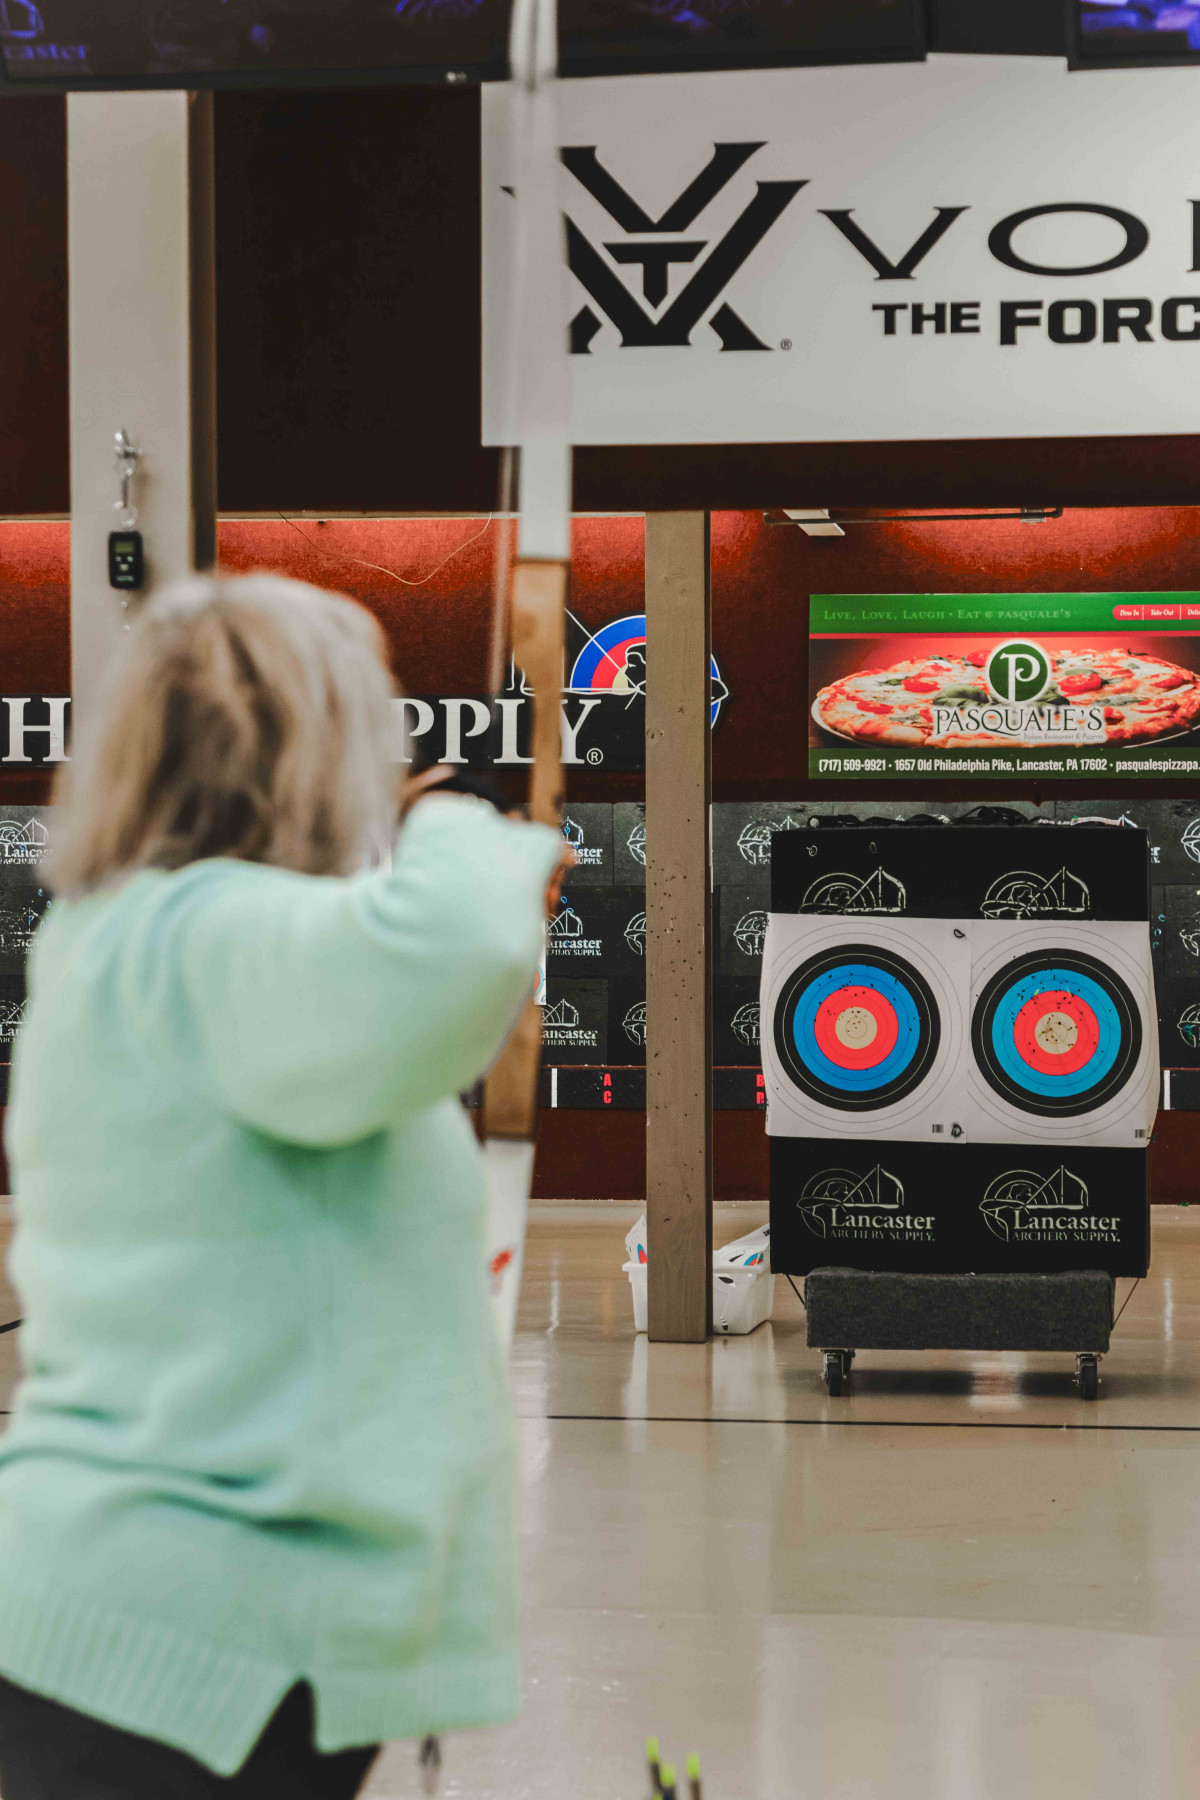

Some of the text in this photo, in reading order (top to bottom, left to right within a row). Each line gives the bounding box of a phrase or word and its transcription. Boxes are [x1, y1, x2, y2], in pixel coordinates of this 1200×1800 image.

[816, 200, 1200, 280] VO
[872, 302, 981, 336] THE
[824, 609, 856, 621] LIVE,
[862, 609, 897, 621] LOVE,
[903, 609, 945, 620] LAUGH
[958, 609, 980, 619] EAT
[1163, 608, 1174, 616] Out
[1000, 652, 1041, 702] P
[934, 708, 1103, 737] PASQUALE'S
[818, 759, 841, 772] (717)
[843, 759, 886, 771] 509-9921
[894, 759, 916, 771] 1657
[917, 759, 932, 771] Old
[933, 759, 990, 773] Philadelphia
[992, 759, 1015, 772] Pike,
[1016, 758, 1065, 772] Lancaster,
[1066, 758, 1078, 771] PA
[1080, 758, 1107, 771] 17602
[603, 1073, 612, 1087] A
[603, 1090, 612, 1104] C
[831, 1207, 936, 1228] Lancaster
[1013, 1209, 1121, 1230] Lancaster
[830, 1229, 886, 1240] ARCHERY
[1012, 1231, 1069, 1242] ARCHERY
